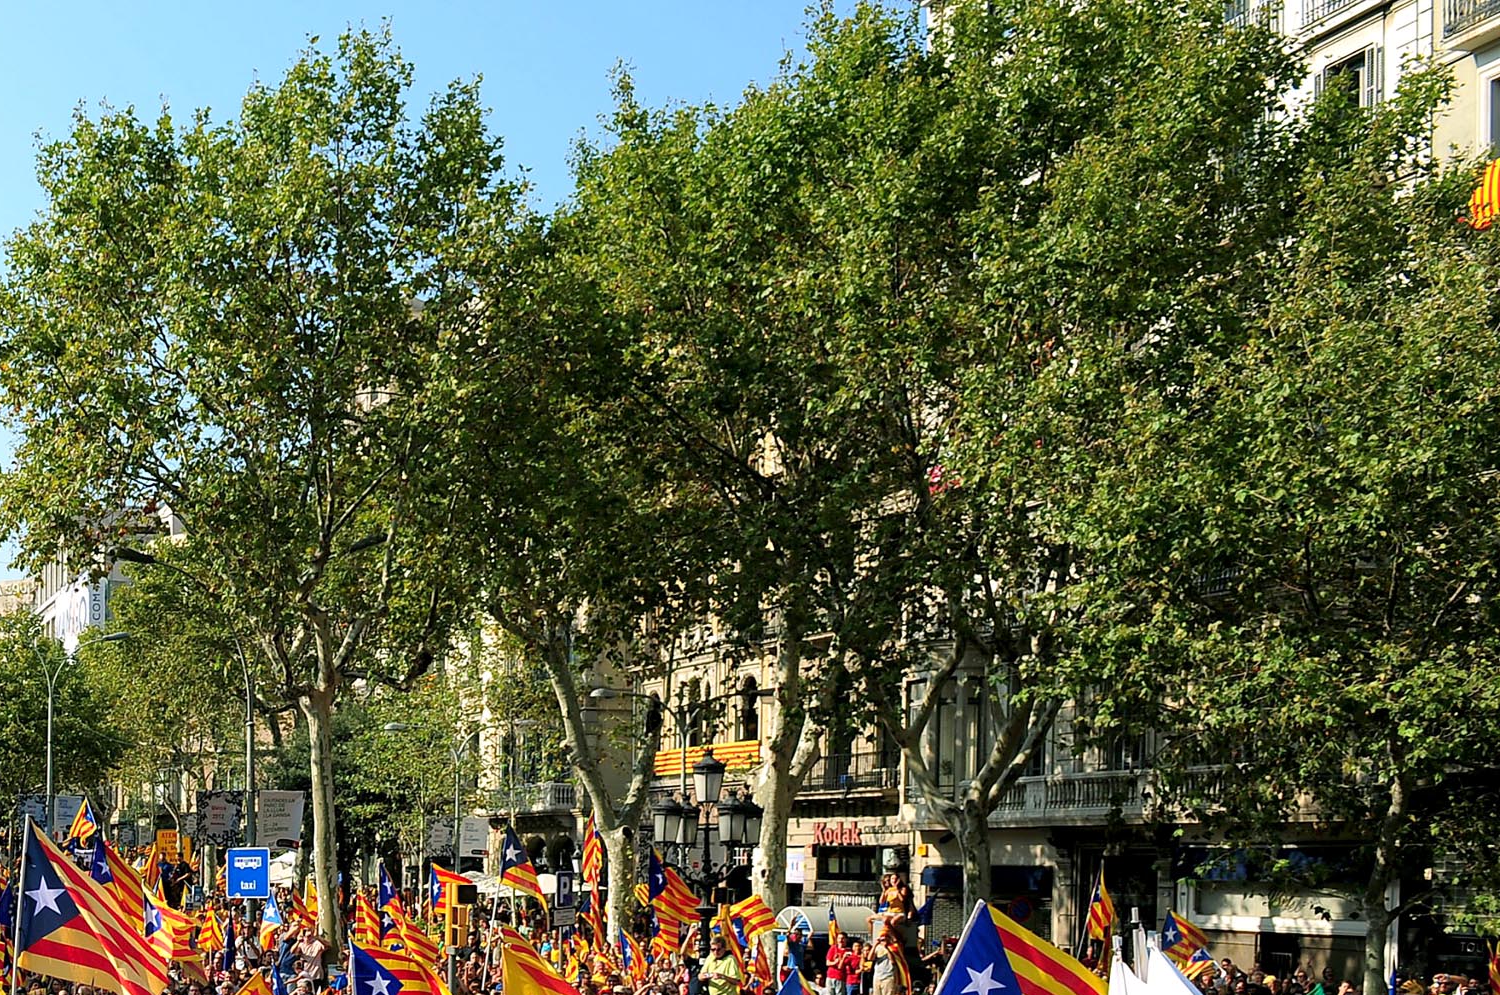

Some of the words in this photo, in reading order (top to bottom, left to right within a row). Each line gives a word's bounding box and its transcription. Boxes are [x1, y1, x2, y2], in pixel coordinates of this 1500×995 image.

[813, 821, 862, 844] Kodak
[240, 880, 256, 890] taxi
[560, 876, 571, 904] P
[1460, 942, 1483, 952] TOU
